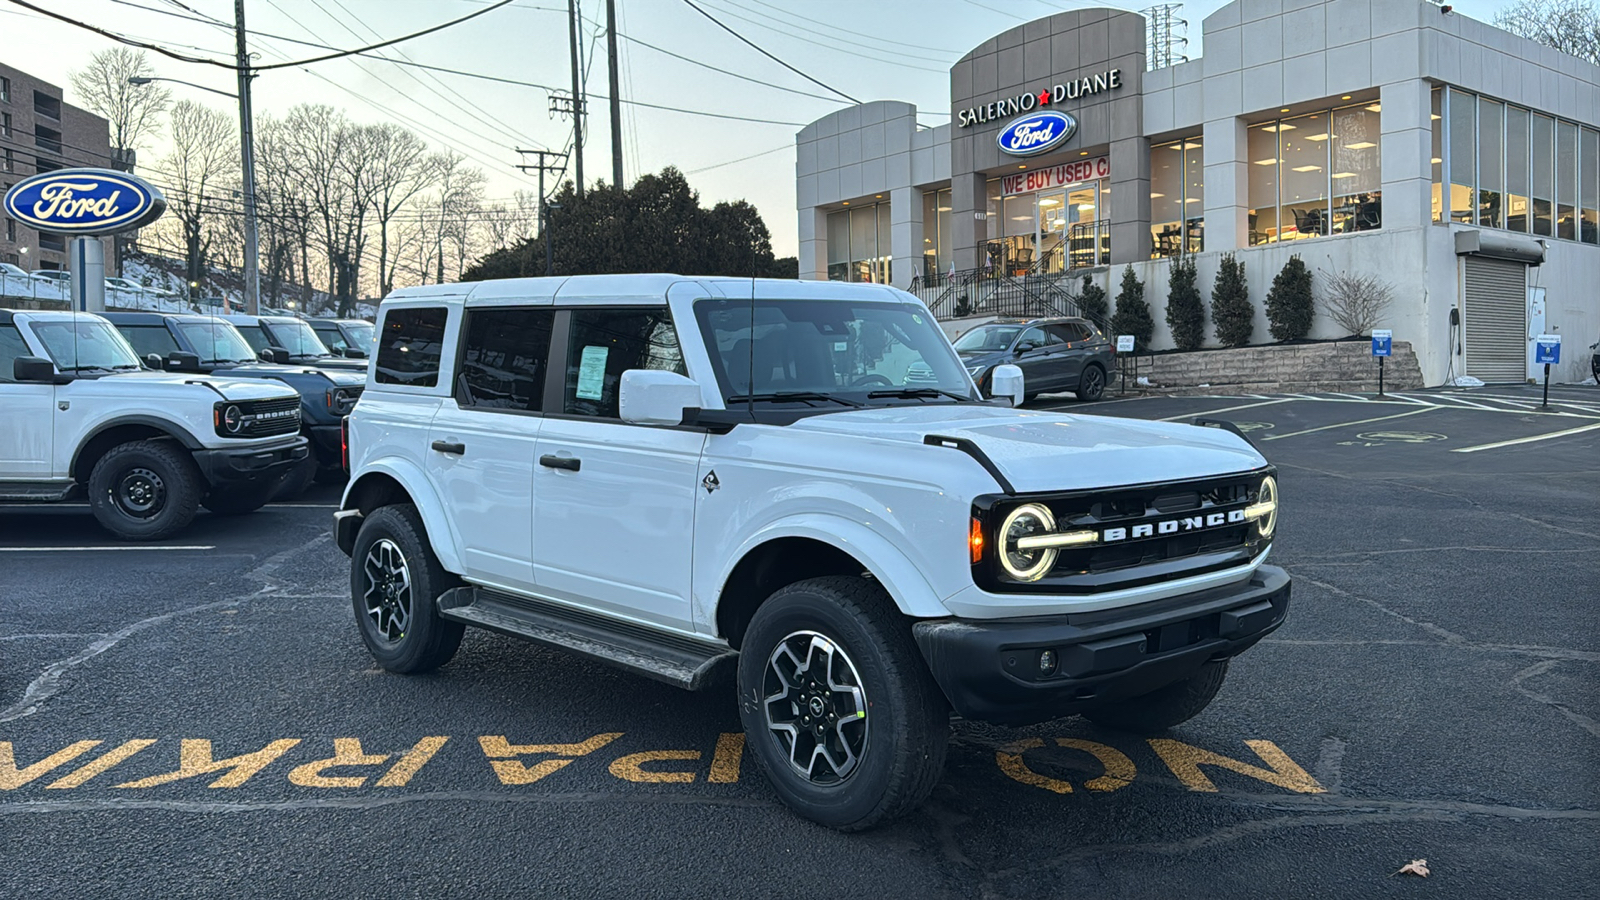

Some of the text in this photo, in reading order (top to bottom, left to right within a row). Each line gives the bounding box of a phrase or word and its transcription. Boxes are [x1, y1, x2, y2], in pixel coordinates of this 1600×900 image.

[958, 69, 1121, 128] SALERNO DUANE
[1010, 120, 1054, 149] Ford
[1003, 157, 1110, 195] WE BUY USED C
[33, 182, 121, 219] Ford
[256, 409, 298, 420] BRONCO
[1103, 509, 1245, 542] BRONCO
[996, 738, 1328, 795] NO
